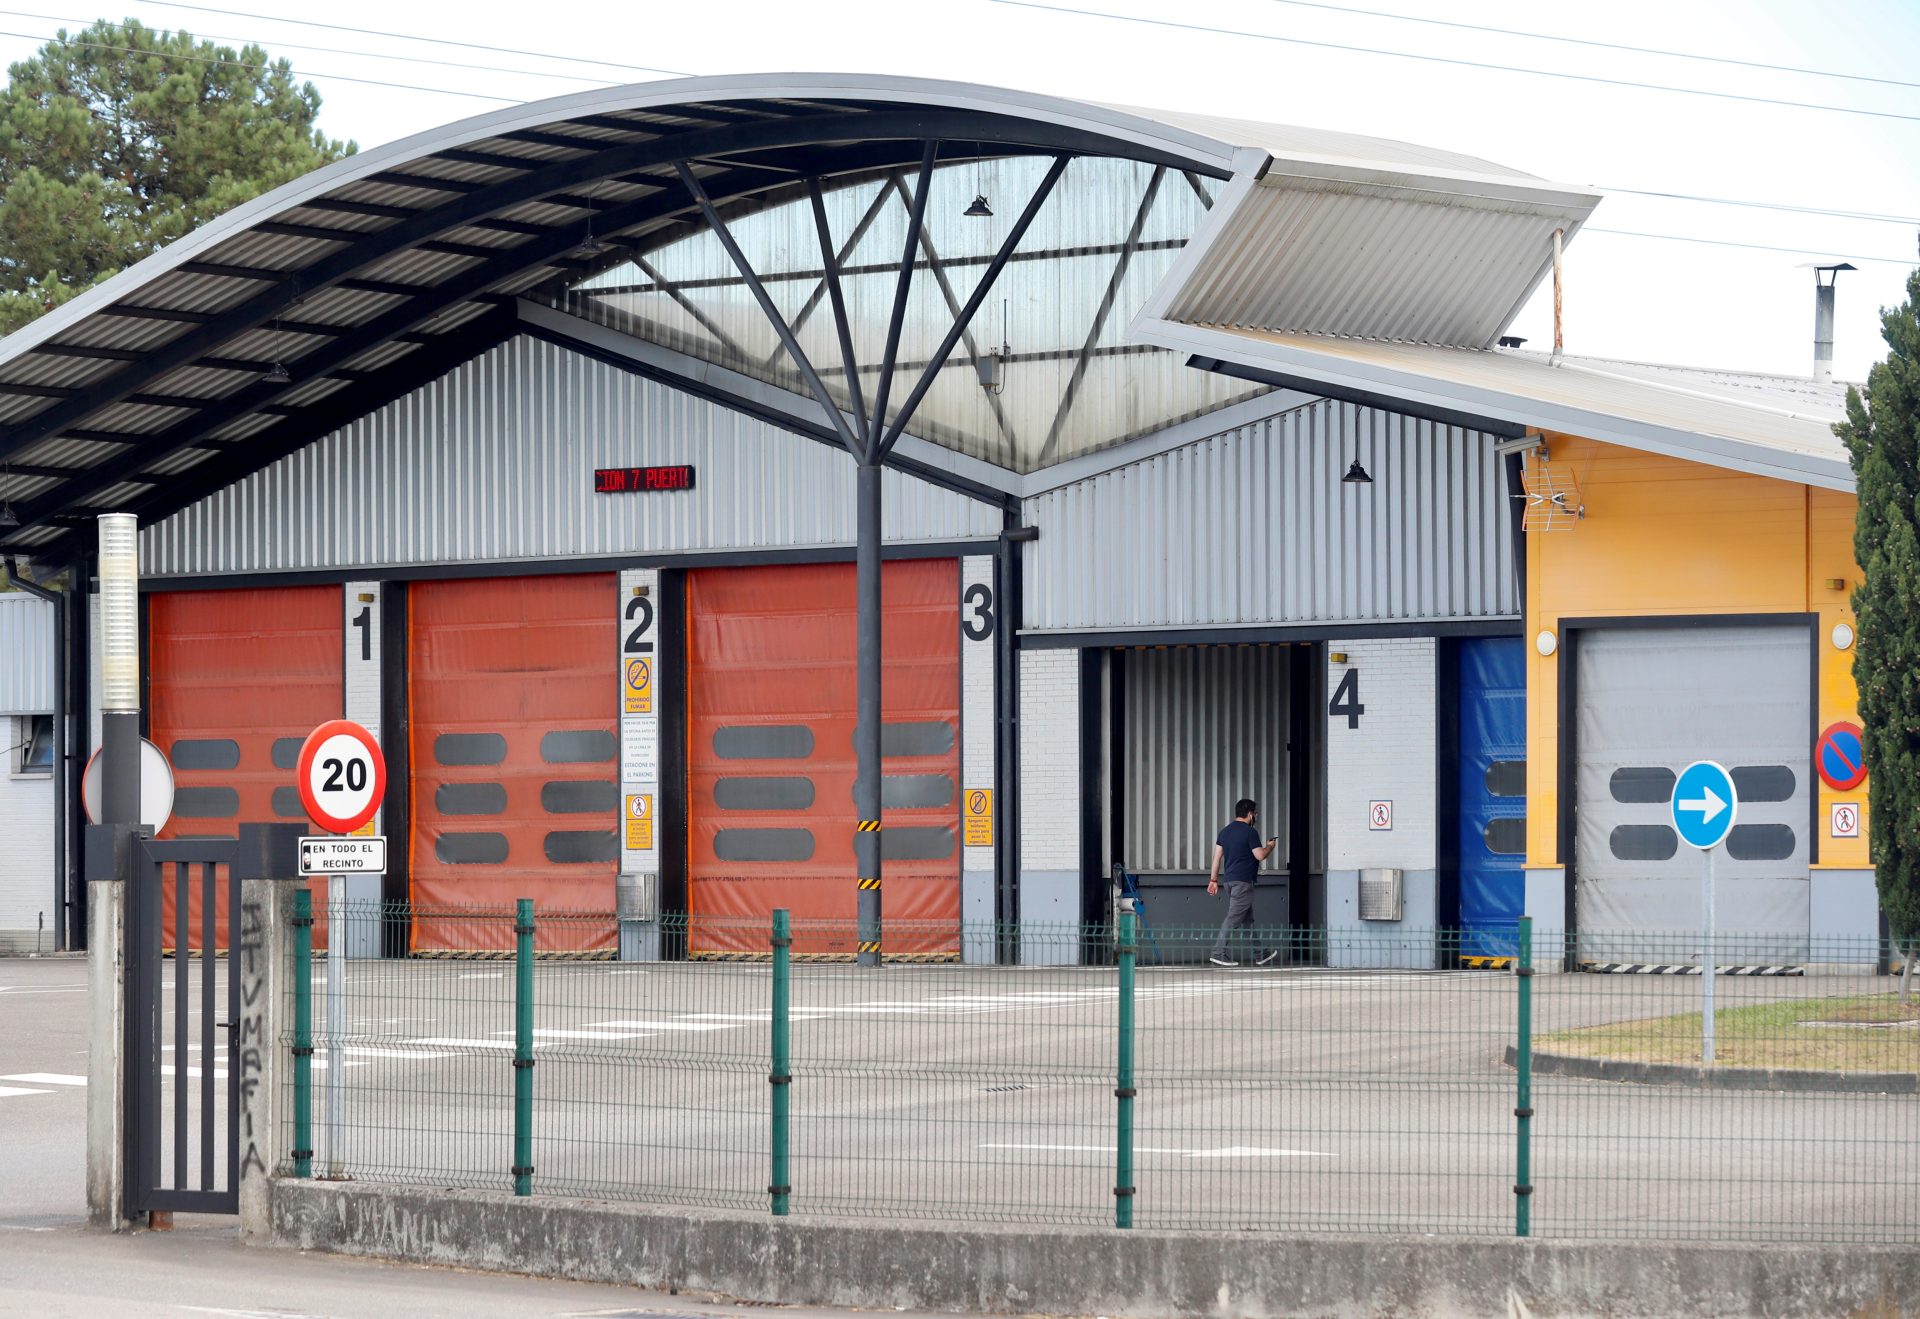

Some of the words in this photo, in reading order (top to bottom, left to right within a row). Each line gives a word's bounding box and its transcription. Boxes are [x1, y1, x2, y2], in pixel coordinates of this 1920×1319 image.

[631, 469, 640, 489] 7
[353, 607, 370, 660] 1
[624, 597, 653, 652] 2
[962, 583, 994, 641] 3
[1329, 668, 1364, 729] 4
[322, 758, 367, 792] 20
[313, 845, 326, 853] EN
[331, 845, 357, 853] TODO
[323, 860, 364, 868] RECINTO
[241, 1013, 266, 1182] MAFIA
